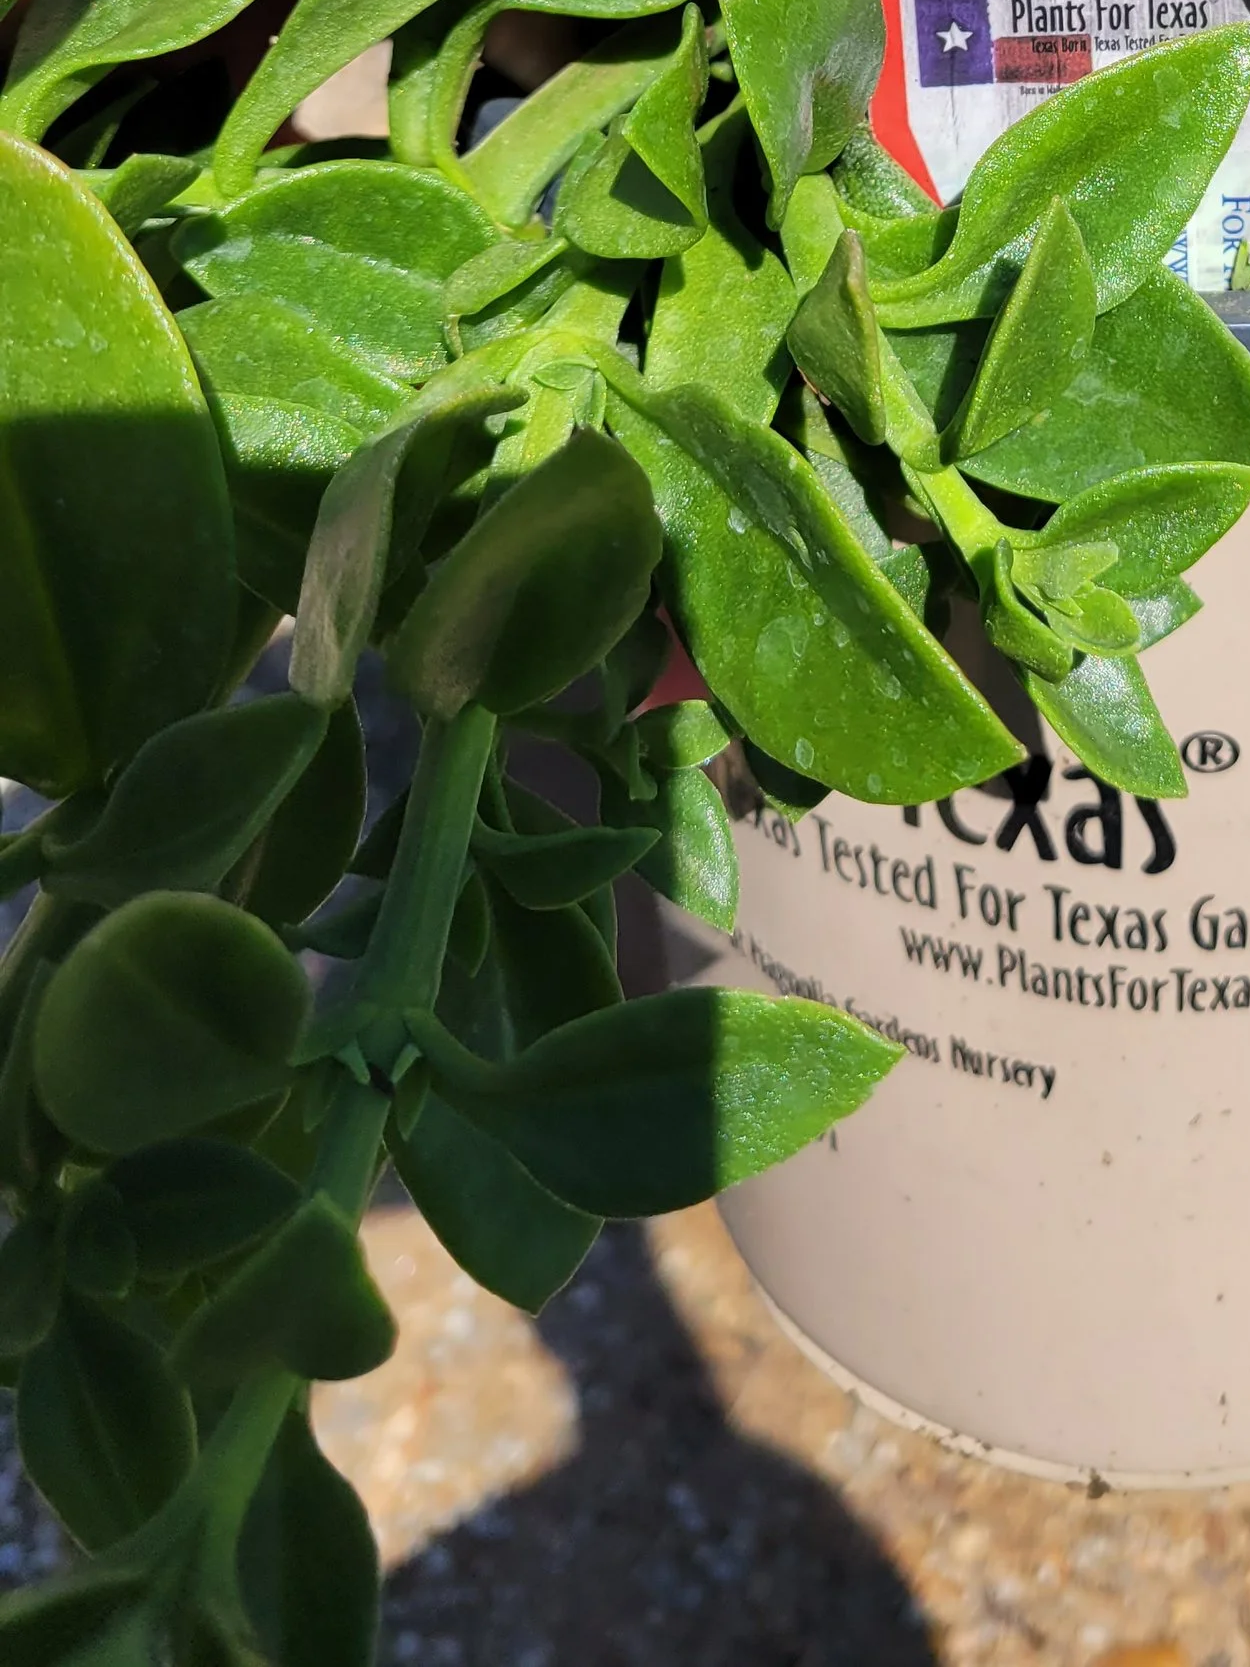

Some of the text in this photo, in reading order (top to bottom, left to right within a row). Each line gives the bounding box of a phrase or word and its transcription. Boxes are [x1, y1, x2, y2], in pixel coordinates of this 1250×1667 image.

[1031, 37, 1058, 53] Texas
[1094, 36, 1121, 51] Texas
[1125, 34, 1155, 51] Tested
[810, 812, 938, 910] Tested
[953, 861, 1027, 932] For
[1043, 883, 1170, 953] Texas
[950, 1034, 1056, 1100] Nursery
